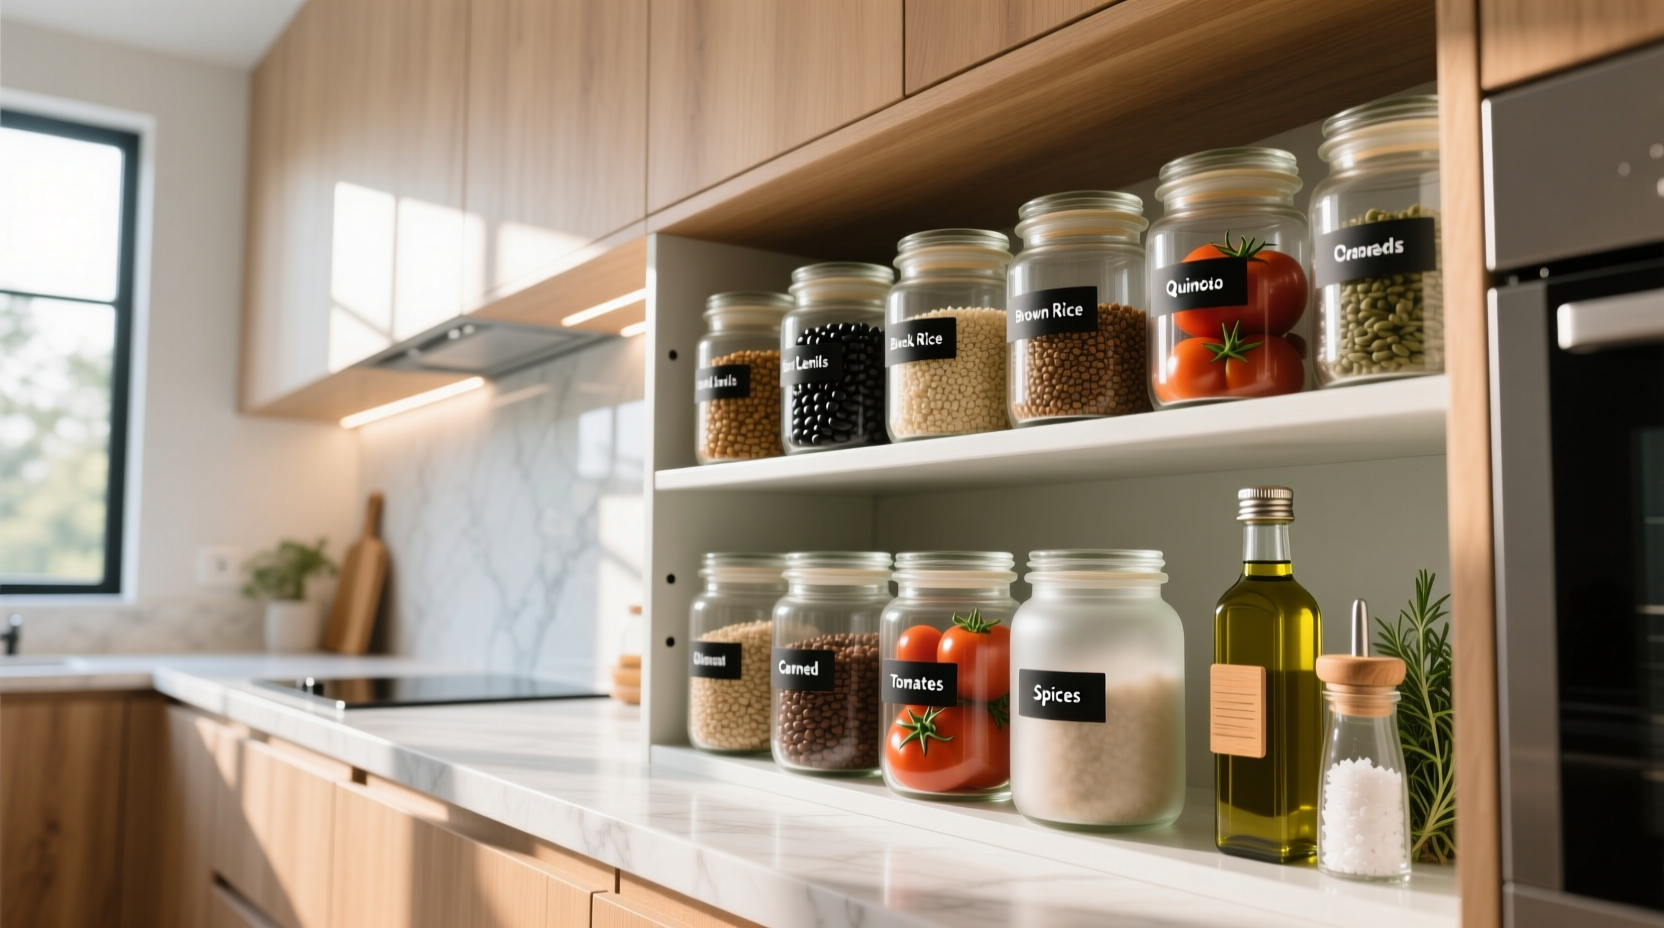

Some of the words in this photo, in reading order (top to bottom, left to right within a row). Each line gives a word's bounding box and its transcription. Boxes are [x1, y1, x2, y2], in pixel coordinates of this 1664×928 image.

[1052, 301, 1084, 319] Rice
[916, 331, 943, 346] Rice
[1032, 683, 1081, 707] Spices
